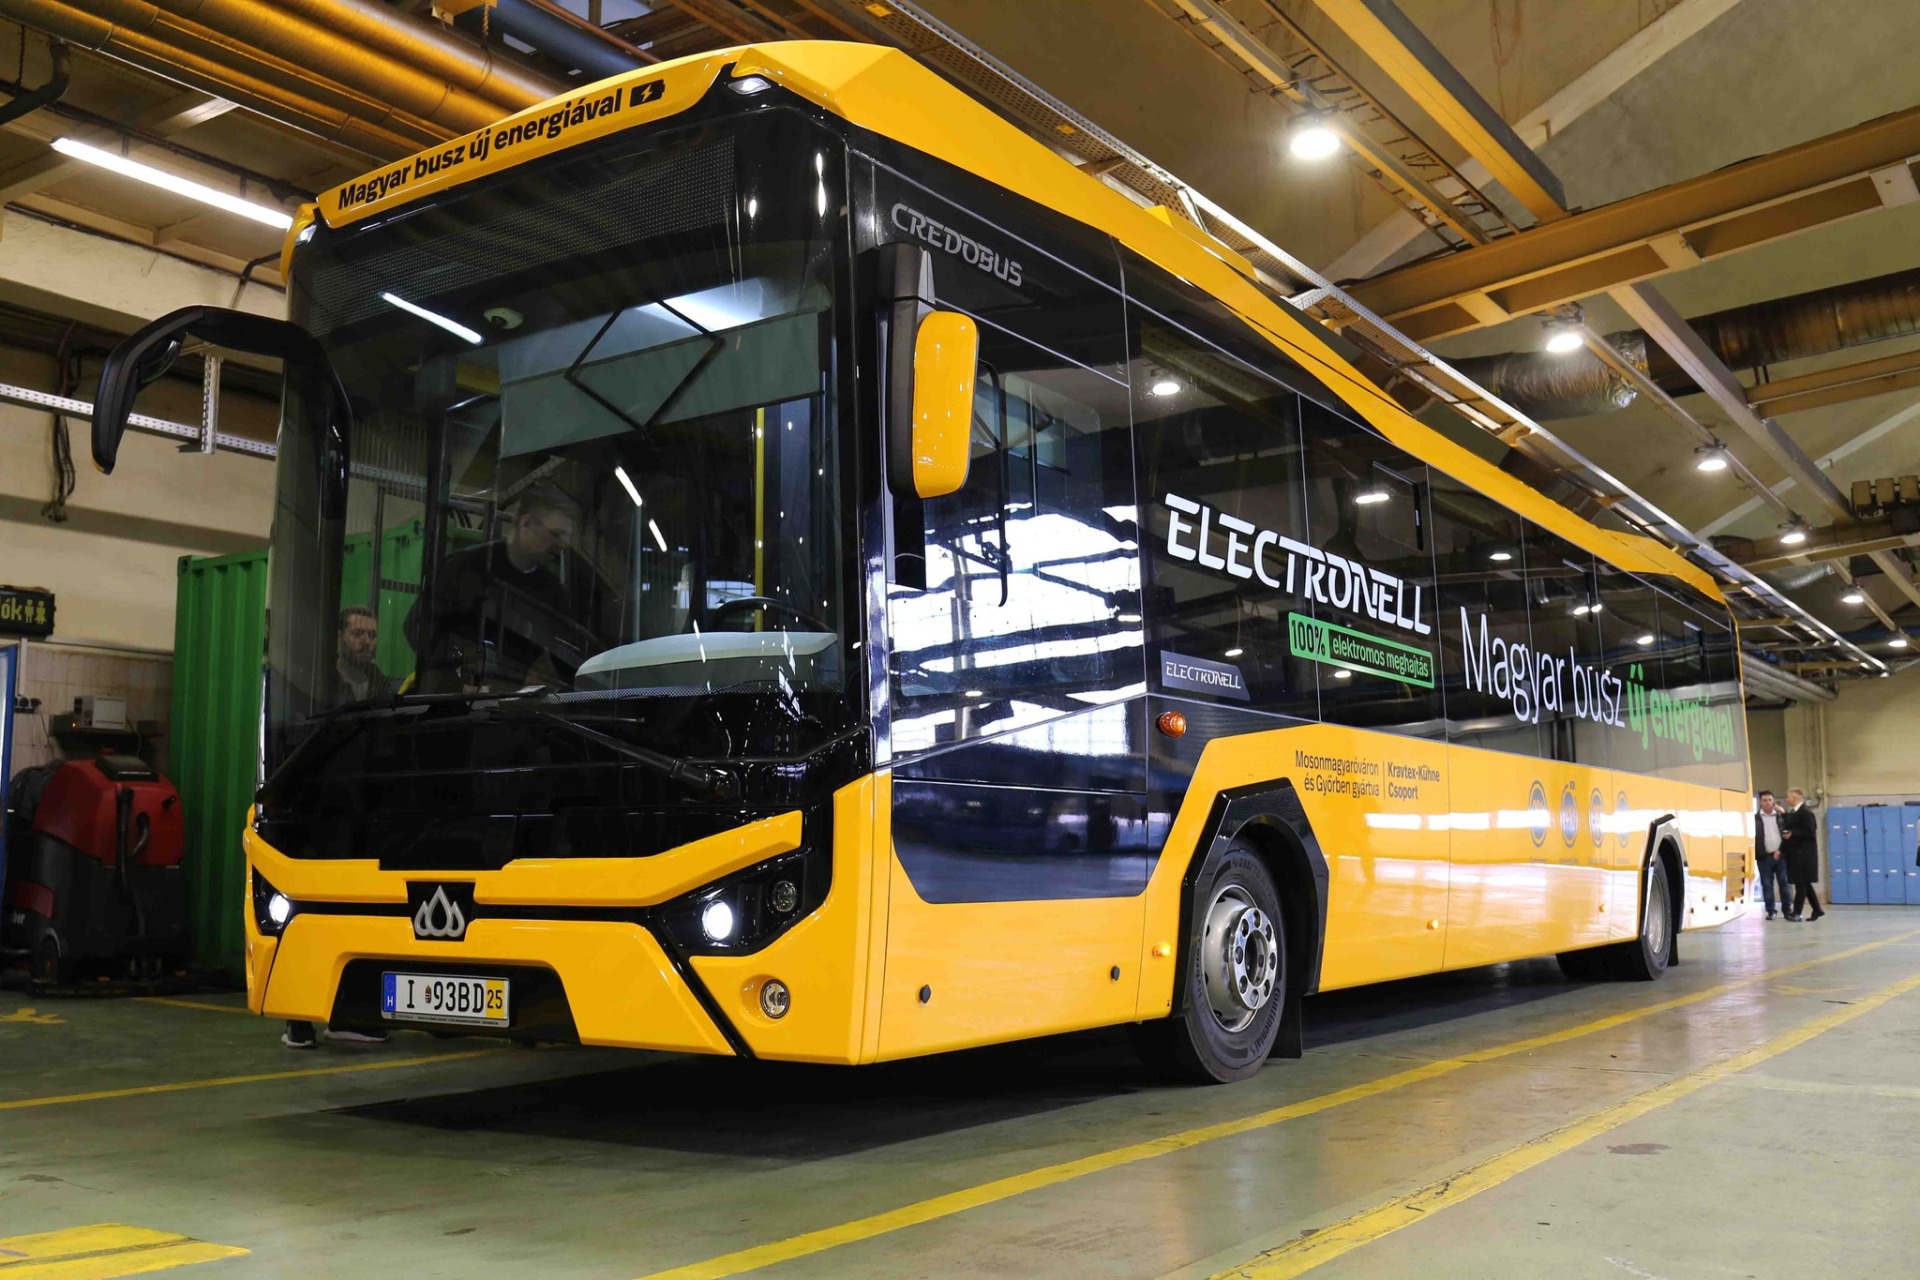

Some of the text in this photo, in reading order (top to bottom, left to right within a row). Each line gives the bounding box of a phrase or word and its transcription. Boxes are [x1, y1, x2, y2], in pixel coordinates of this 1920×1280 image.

[338, 88, 622, 210] Magyar busz új energiával
[891, 202, 1023, 287] CREDOBUS
[1165, 492, 1431, 635] ELECTRONELL
[1165, 661, 1242, 689] ELECTRONELL
[1291, 619, 1429, 678] 100% elektromos meghajtás
[1460, 605, 1735, 762] Magyar busz új energiával
[1295, 750, 1440, 783] Mosonmagyaróváron Kravtex-Kühne
[1304, 773, 1419, 802] és Győrben gyártva Csoport
[387, 995, 394, 1007] H
[433, 981, 485, 1013] 93BD
[487, 989, 503, 1009] 25
